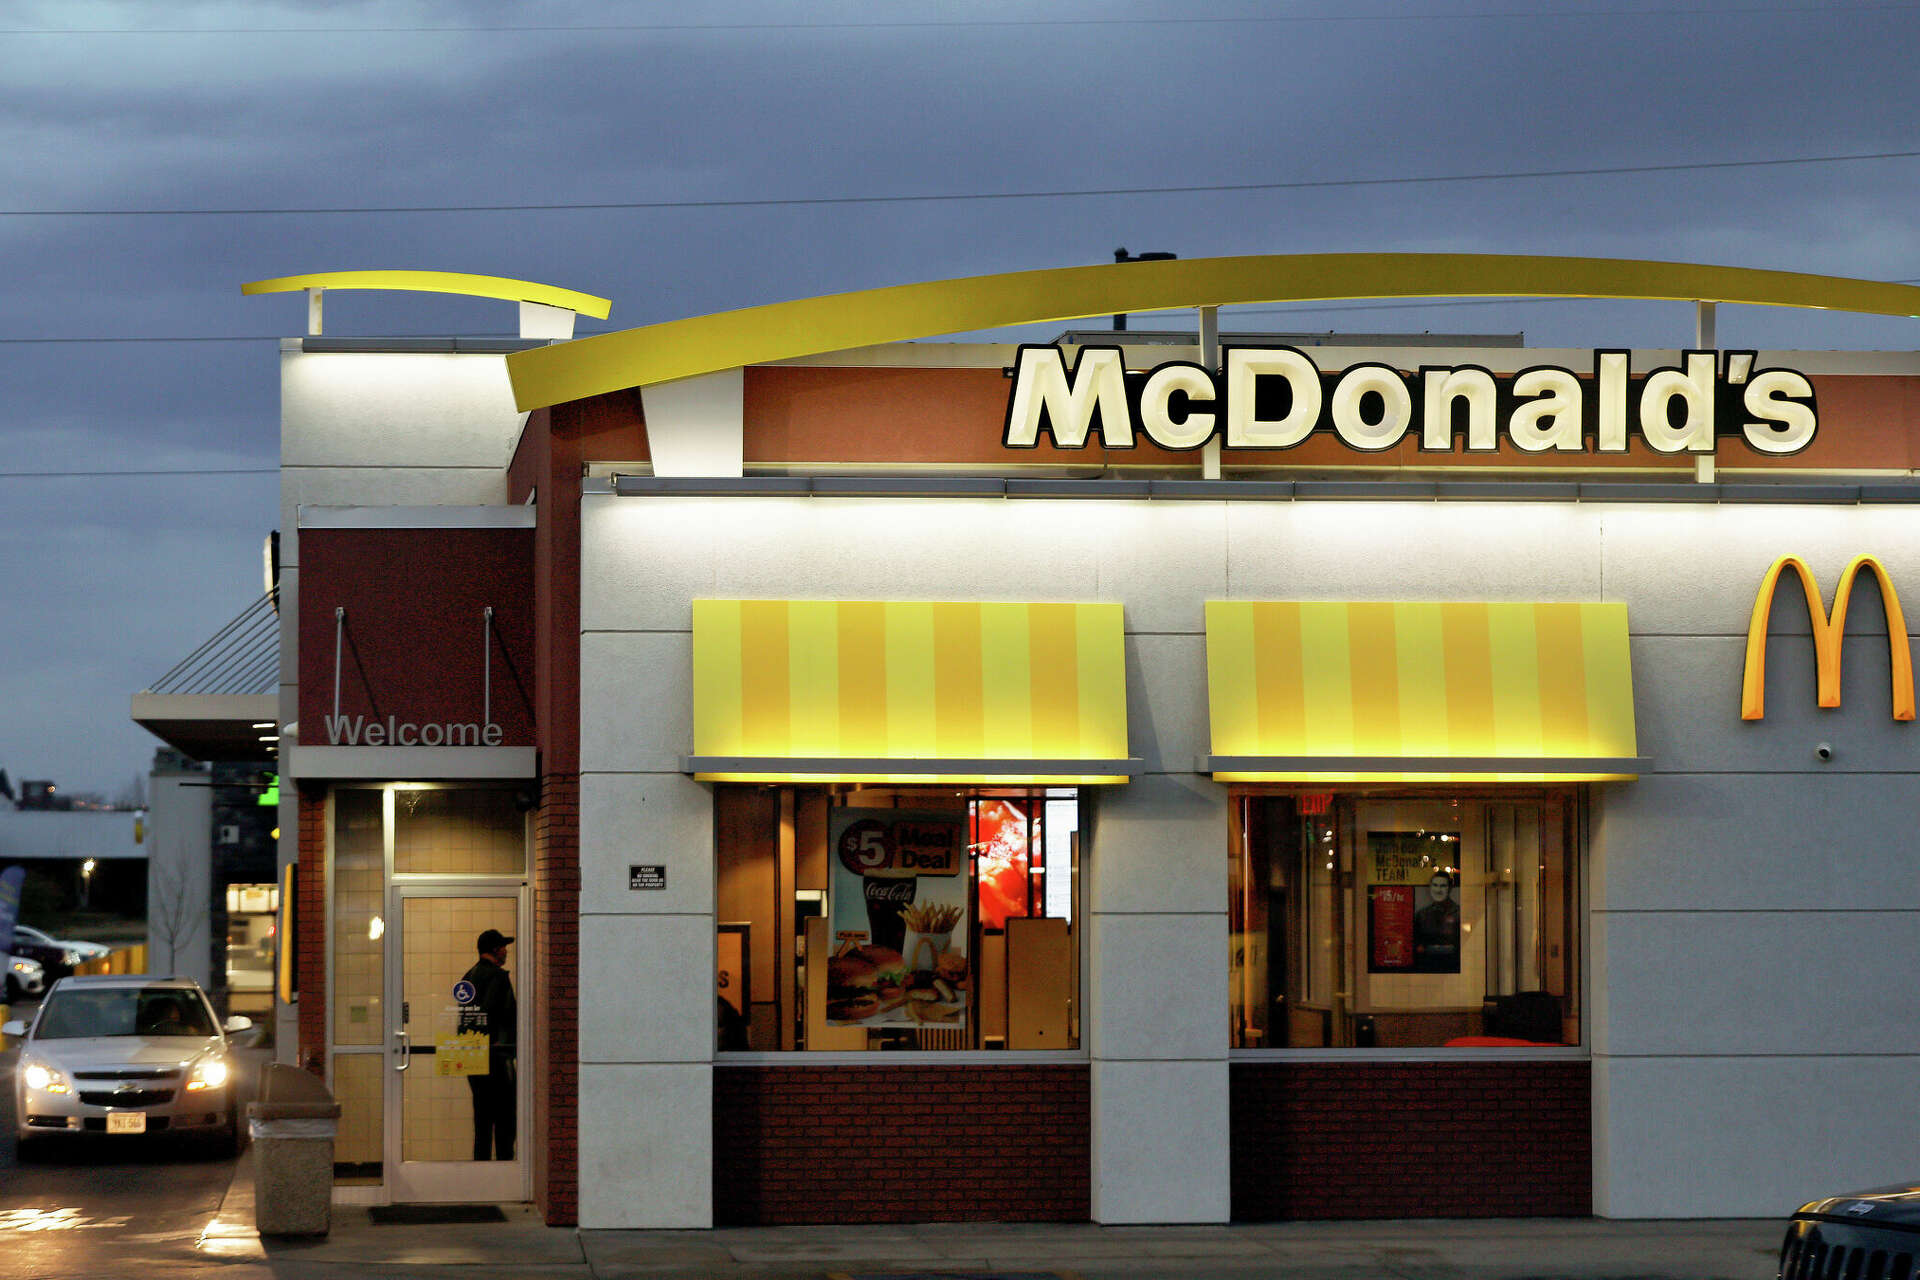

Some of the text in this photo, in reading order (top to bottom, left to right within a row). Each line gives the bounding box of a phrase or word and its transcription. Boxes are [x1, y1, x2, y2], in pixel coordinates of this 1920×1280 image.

[1004, 345, 1817, 453] McDonald's
[324, 715, 503, 746] Welcome
[846, 831, 886, 867] $5
[901, 829, 952, 847] Meal
[902, 850, 951, 869] Deal
[1376, 868, 1409, 881] TEAM!
